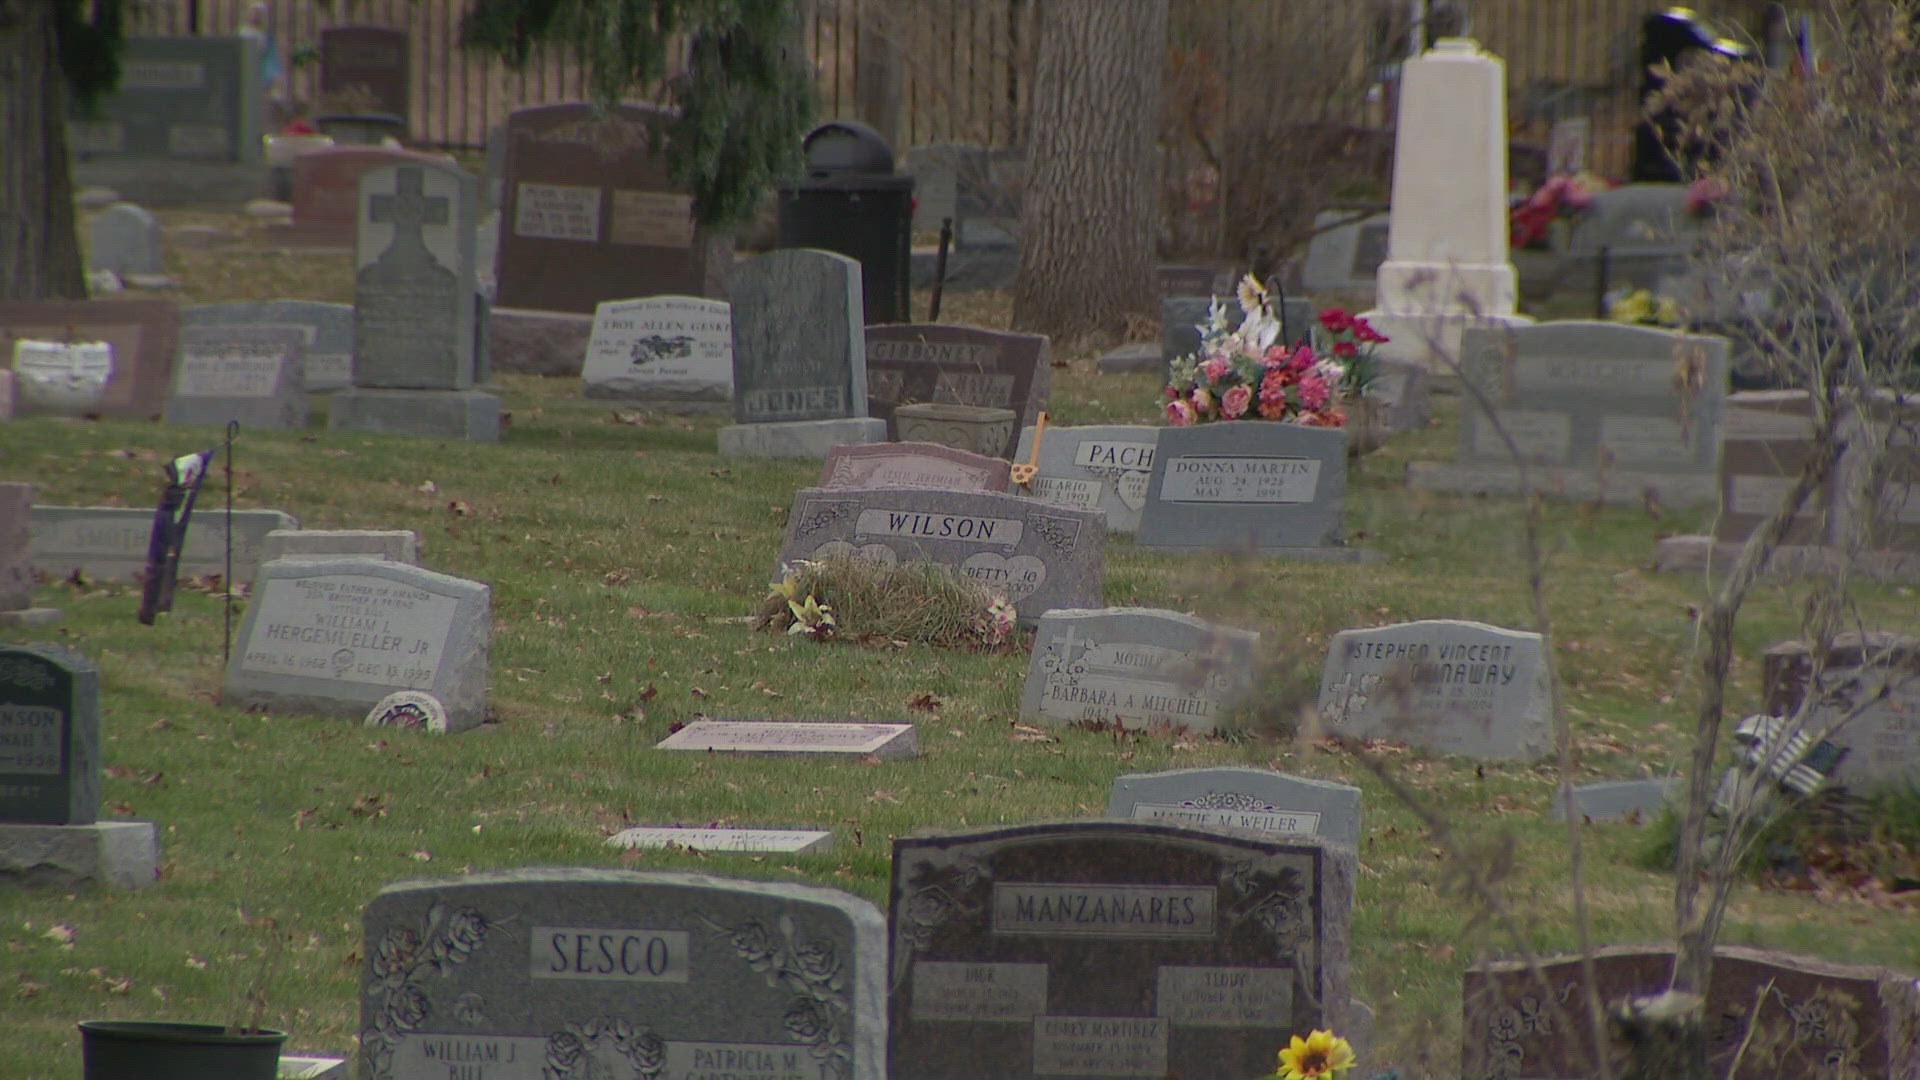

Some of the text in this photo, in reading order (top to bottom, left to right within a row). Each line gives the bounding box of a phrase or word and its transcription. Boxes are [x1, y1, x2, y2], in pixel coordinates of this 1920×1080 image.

[603, 320, 634, 330] TROY
[641, 320, 684, 331] ALLEN
[875, 343, 980, 360] GIBBONEY
[748, 387, 840, 413] JONES
[1089, 444, 1154, 467] PACH
[1175, 462, 1309, 474] DONNA MARTIN
[915, 472, 962, 487] JEREMIAH
[1034, 478, 1087, 491] HILARIO
[1193, 487, 1220, 497] MAY
[888, 512, 996, 539] WILSON
[966, 566, 1038, 583] BETTY JO
[295, 579, 431, 602] BELOVED FATHER OF AMANDA
[328, 592, 370, 604] BROTHER
[381, 597, 415, 610] FRIEND
[315, 612, 377, 632] WILLIAM
[265, 623, 430, 657] HERGEMUELLER JR
[246, 652, 279, 666] APRIL
[1112, 650, 1164, 669] MOTHER
[1353, 641, 1514, 663] STEPHEN VINCENT
[1051, 685, 1209, 717] BARBARA A MITCHELL
[1240, 815, 1298, 832] WEILER
[1016, 894, 1195, 925] MANZANARES
[550, 932, 669, 976] SESCO
[1206, 972, 1248, 989] TEDDY
[1091, 1022, 1158, 1040] MARTINEZ
[422, 1039, 517, 1063] WILLIAM J
[693, 1047, 797, 1072] PATRICIA M
